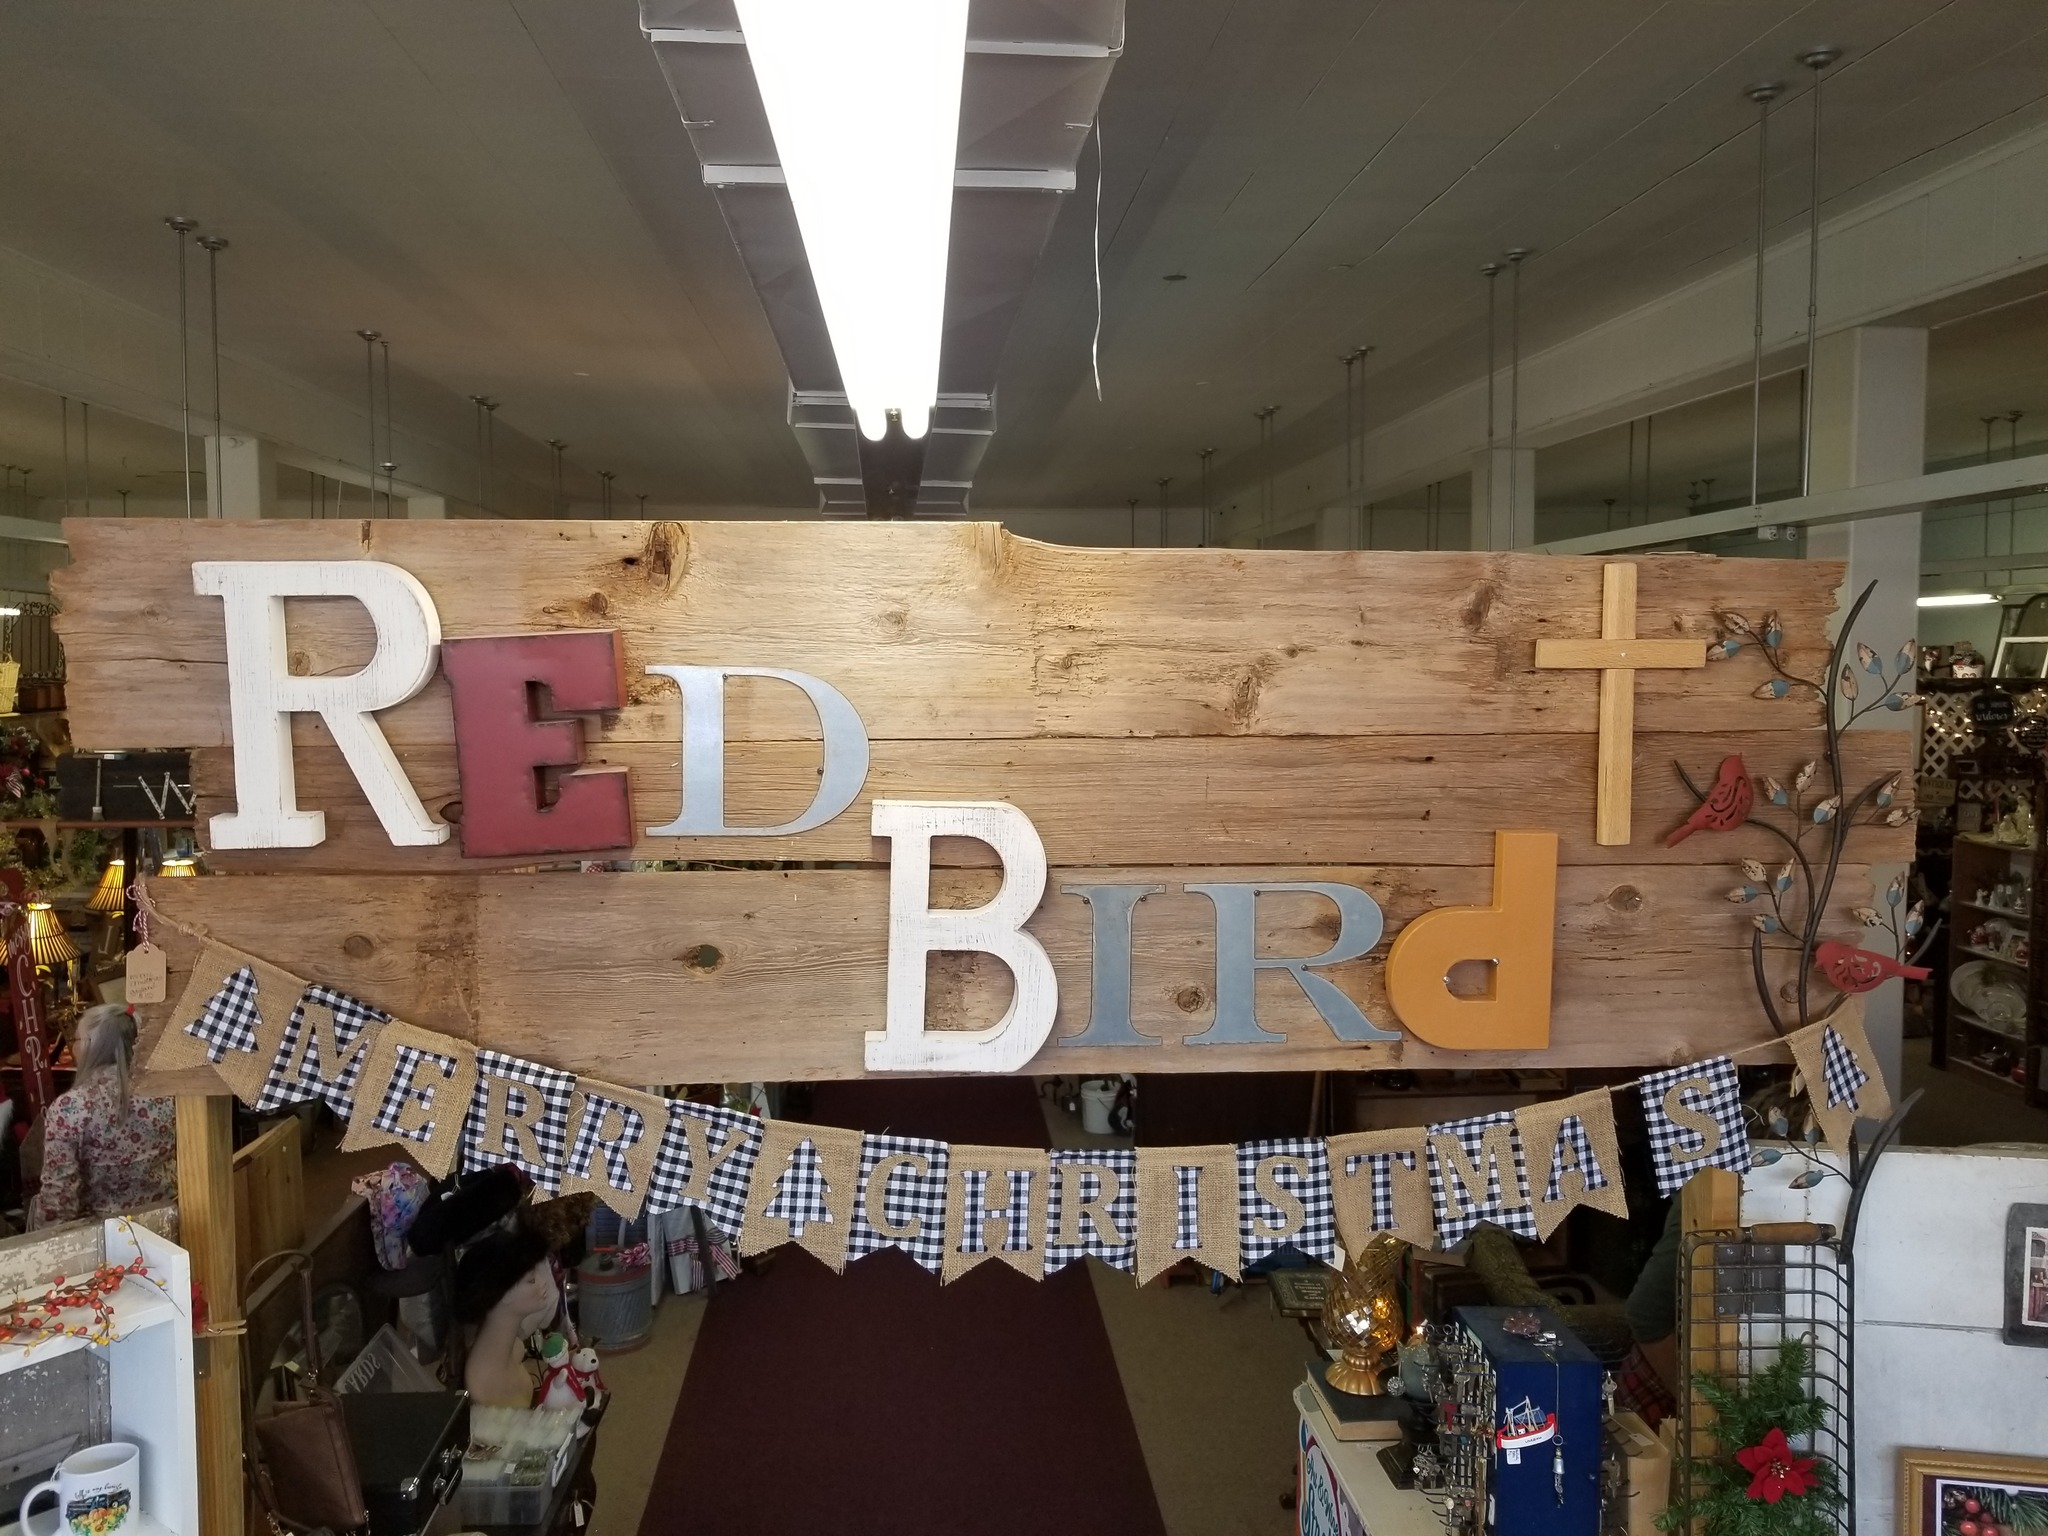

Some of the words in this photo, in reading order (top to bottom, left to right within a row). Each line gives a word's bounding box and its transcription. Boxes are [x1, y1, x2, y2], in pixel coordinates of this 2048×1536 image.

[192, 560, 871, 859] RED
[281, 1003, 752, 1202] MERRY
[864, 1076, 1727, 1254] CHRISTMAS
